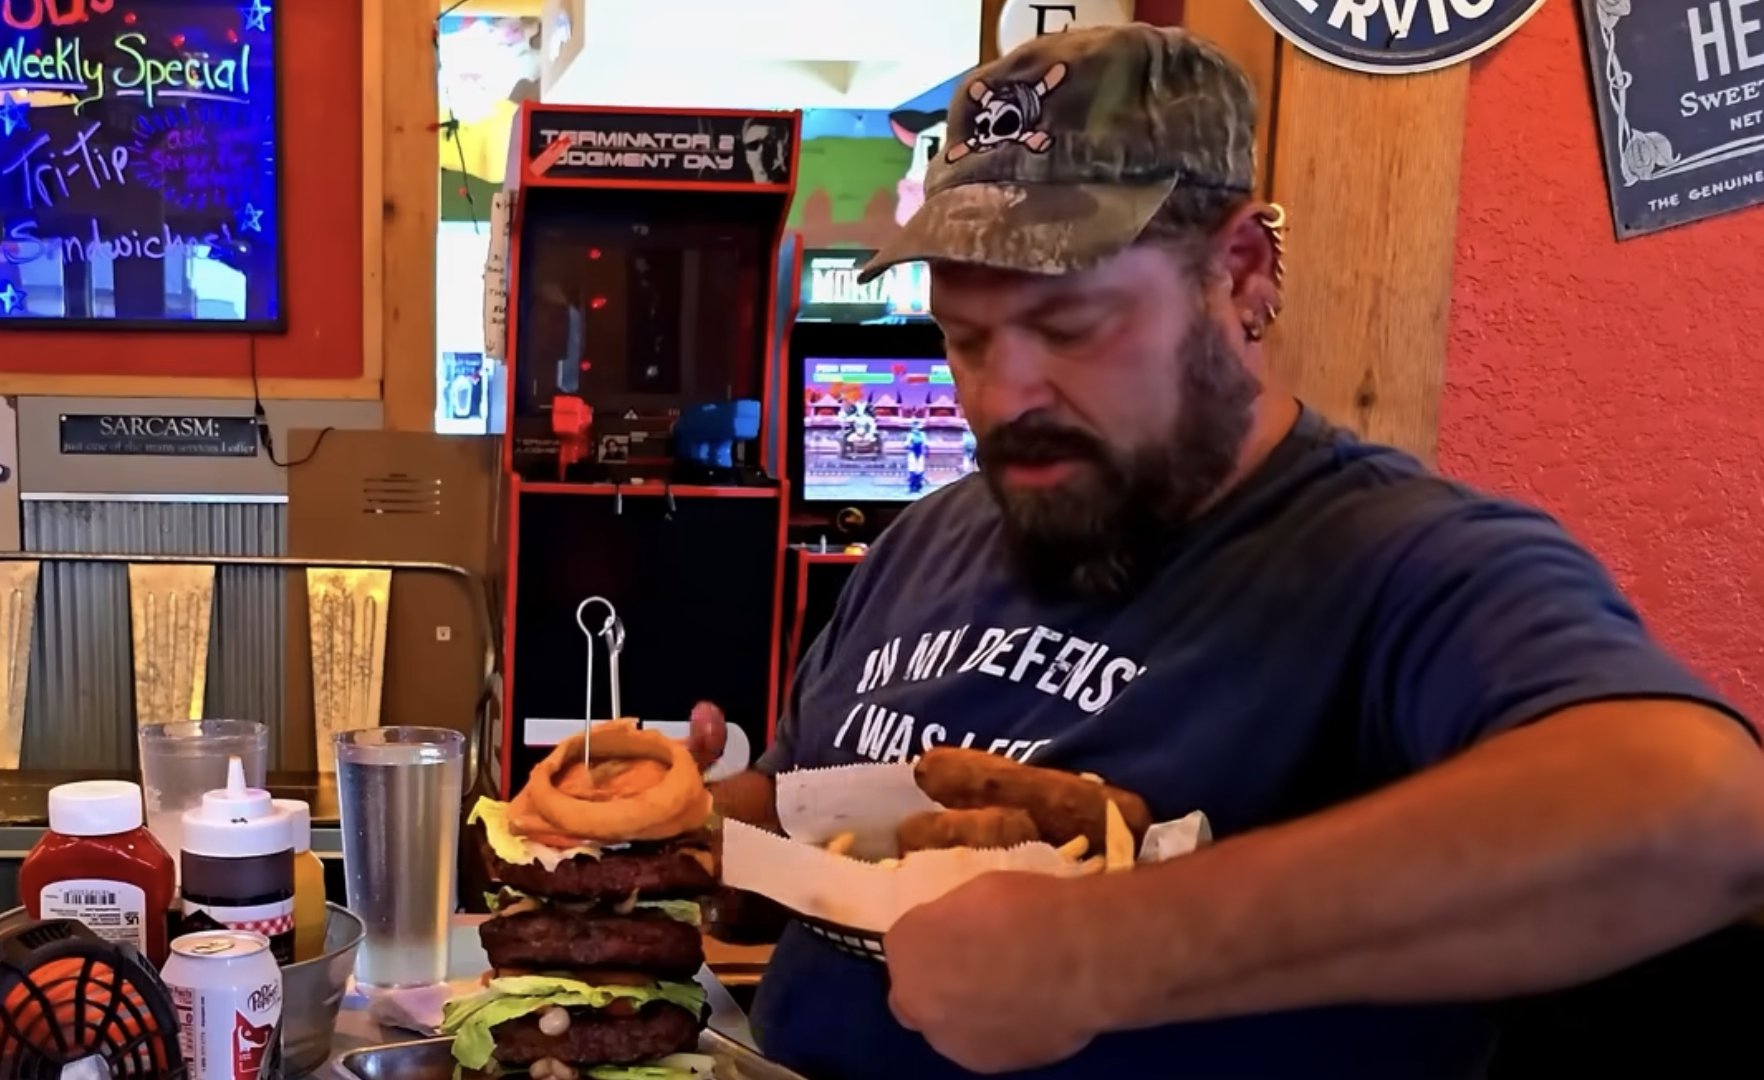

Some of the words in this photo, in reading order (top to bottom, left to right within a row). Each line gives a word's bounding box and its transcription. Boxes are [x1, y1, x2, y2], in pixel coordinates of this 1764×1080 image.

[1299, 0, 1496, 41] RVI
[0, 36, 104, 116] Weekly
[113, 33, 250, 108] Special
[1730, 110, 1763, 131] NET
[551, 150, 676, 168] UDGMENT
[683, 153, 734, 170] DAY
[719, 134, 735, 150] 2
[2, 121, 128, 208] Tri-Tip
[1648, 193, 1680, 212] THE
[1688, 170, 1764, 201] GENUINE
[100, 415, 220, 438] SARCASM:
[228, 441, 255, 453] offer
[857, 637, 901, 694] IN
[903, 624, 971, 681] MY
[958, 624, 1148, 714] DEFENS
[834, 702, 863, 748] I
